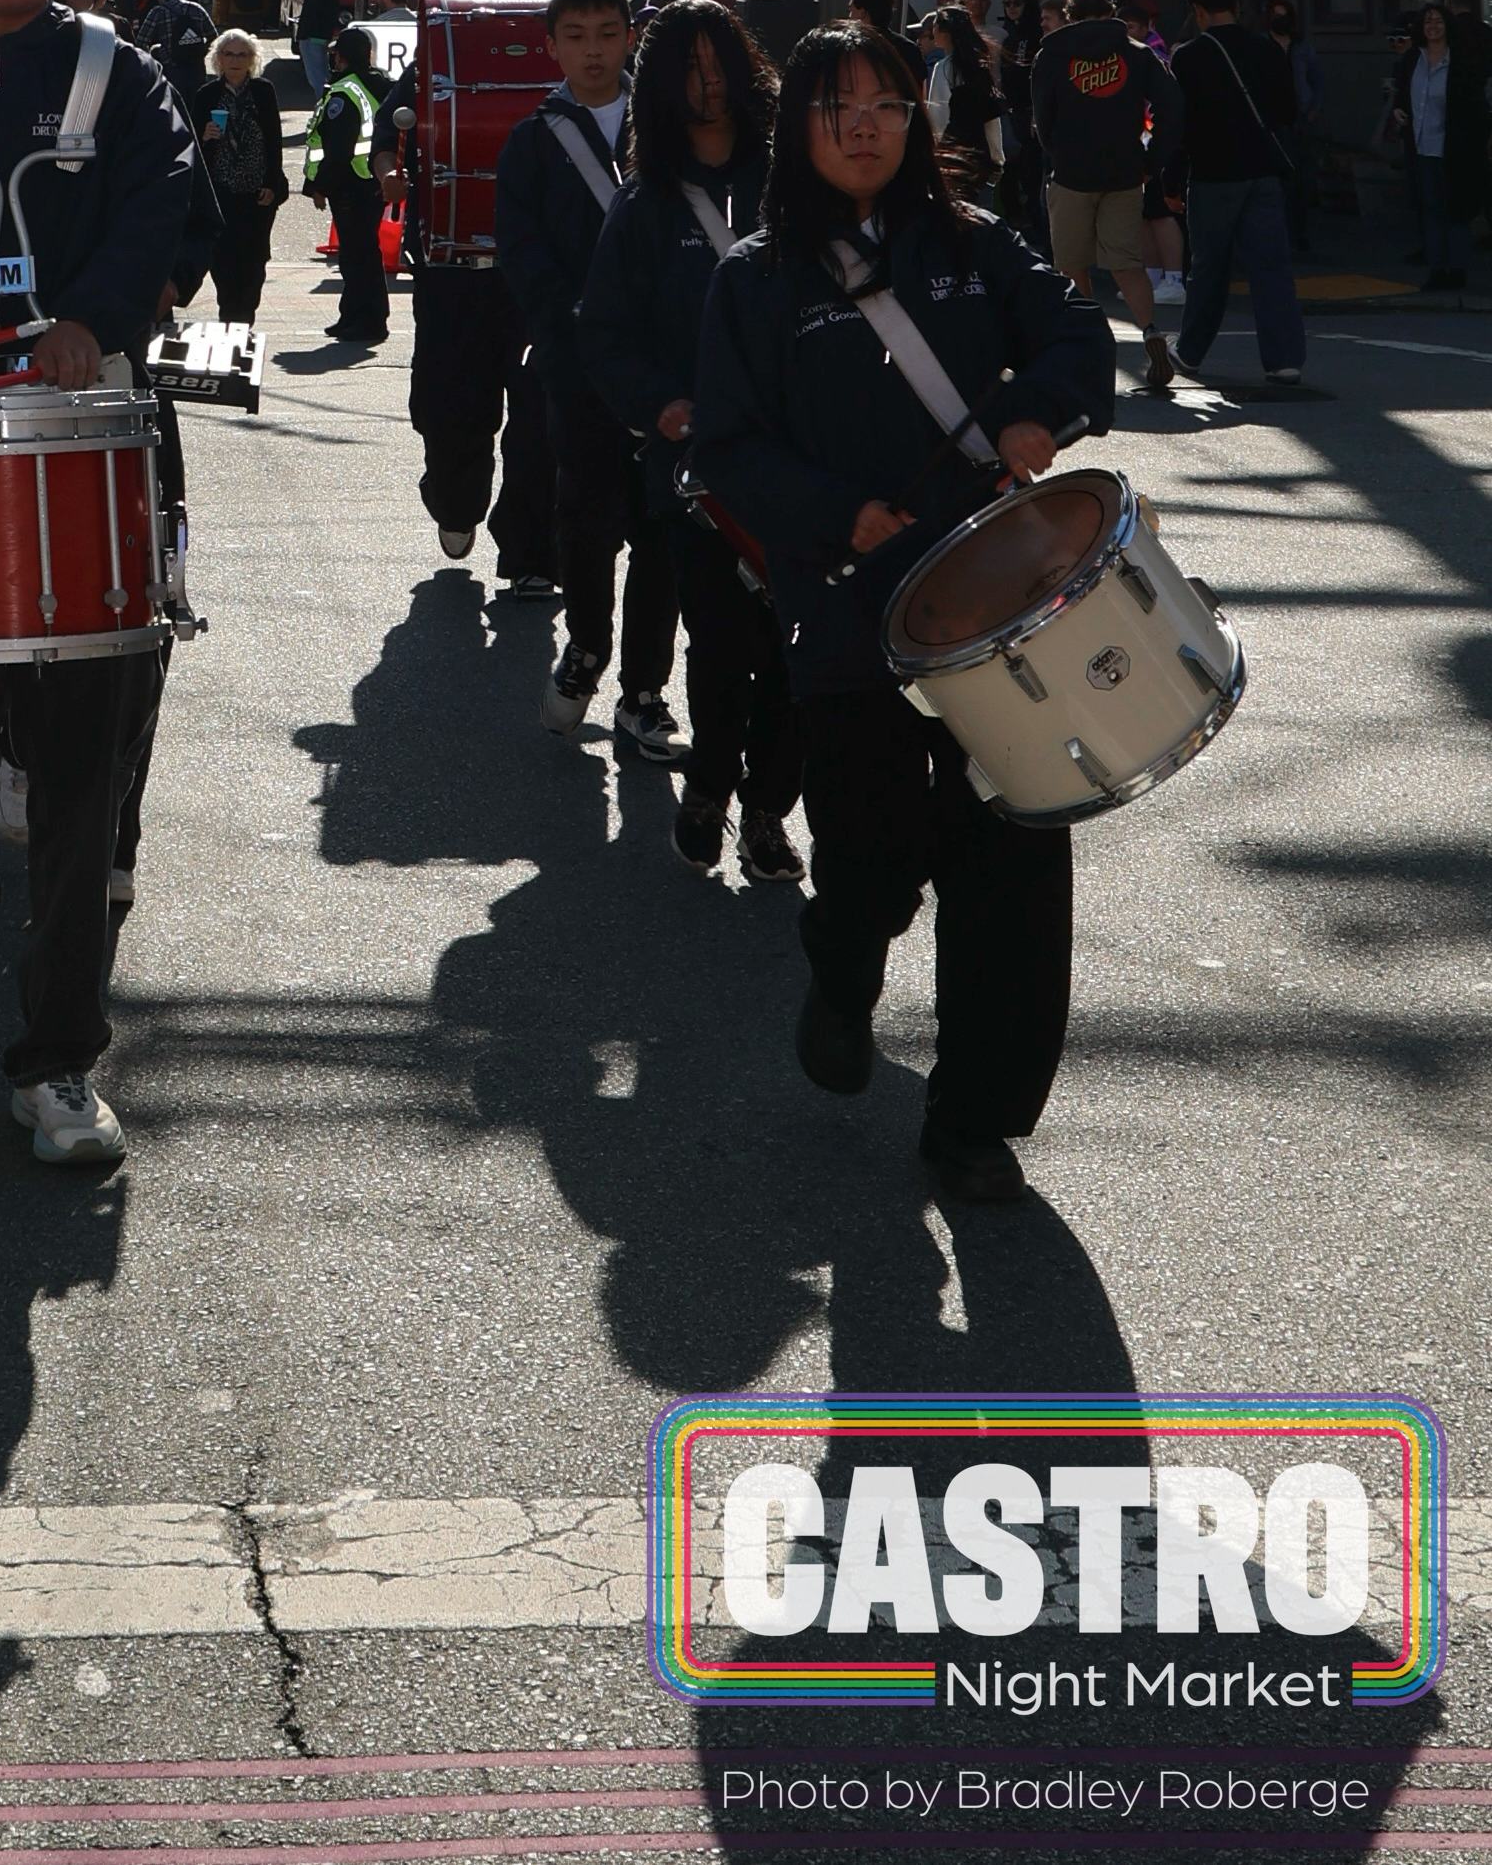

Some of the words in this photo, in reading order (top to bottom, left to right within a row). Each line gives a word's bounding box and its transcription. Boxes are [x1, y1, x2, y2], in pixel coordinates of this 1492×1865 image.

[178, 37, 202, 46] adidas
[1081, 65, 1119, 94] CRUZ
[0, 263, 22, 286] M
